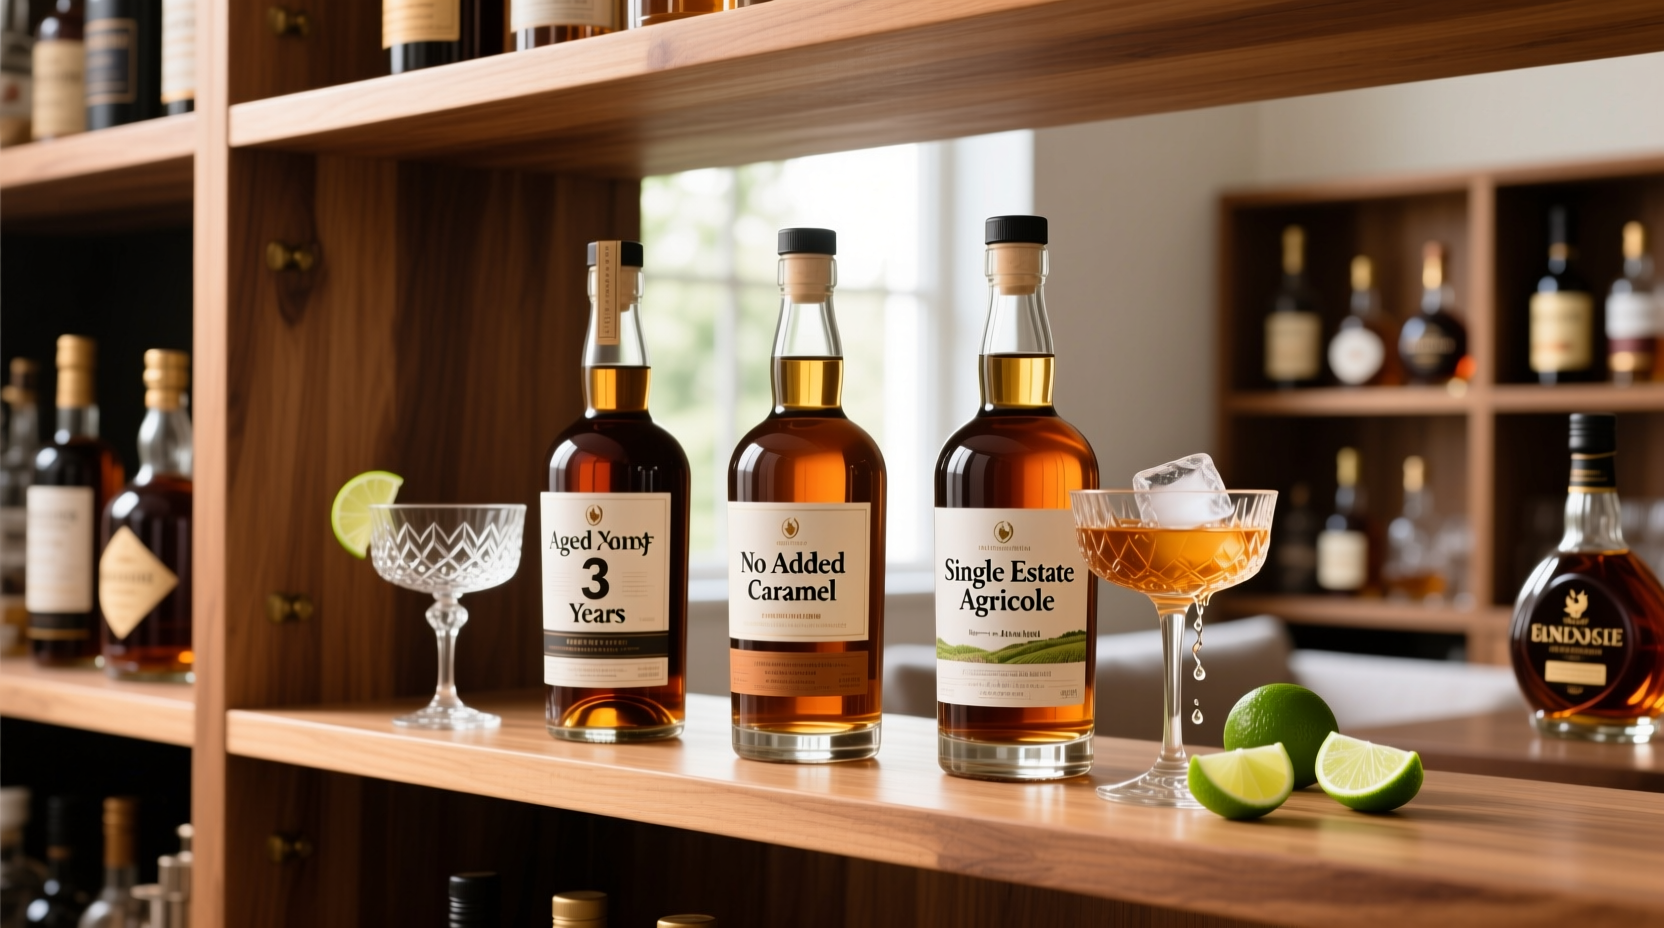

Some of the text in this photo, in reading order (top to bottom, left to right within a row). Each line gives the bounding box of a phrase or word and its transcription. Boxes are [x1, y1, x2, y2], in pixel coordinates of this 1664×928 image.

[549, 530, 592, 556] Aged
[741, 551, 845, 574] No Added
[945, 558, 1074, 589] Single Estate
[581, 557, 610, 600] 3
[748, 579, 837, 601] Caramel
[569, 603, 625, 624] Years
[959, 588, 1054, 617] Agricole
